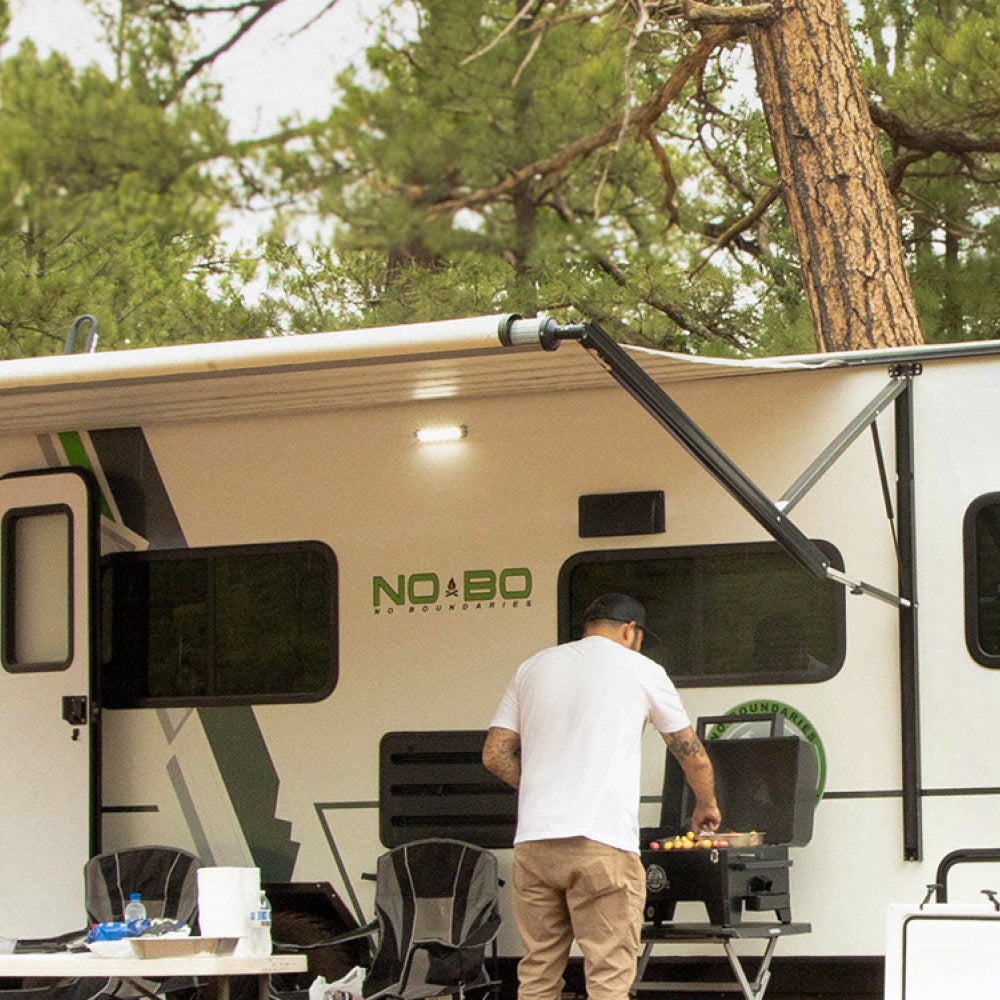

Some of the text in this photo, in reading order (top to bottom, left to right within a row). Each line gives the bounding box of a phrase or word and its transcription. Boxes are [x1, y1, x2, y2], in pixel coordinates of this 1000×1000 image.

[373, 567, 533, 607] NO BO
[373, 600, 532, 615] NO BOUNDARIES
[730, 702, 818, 743] OUNDARIES
